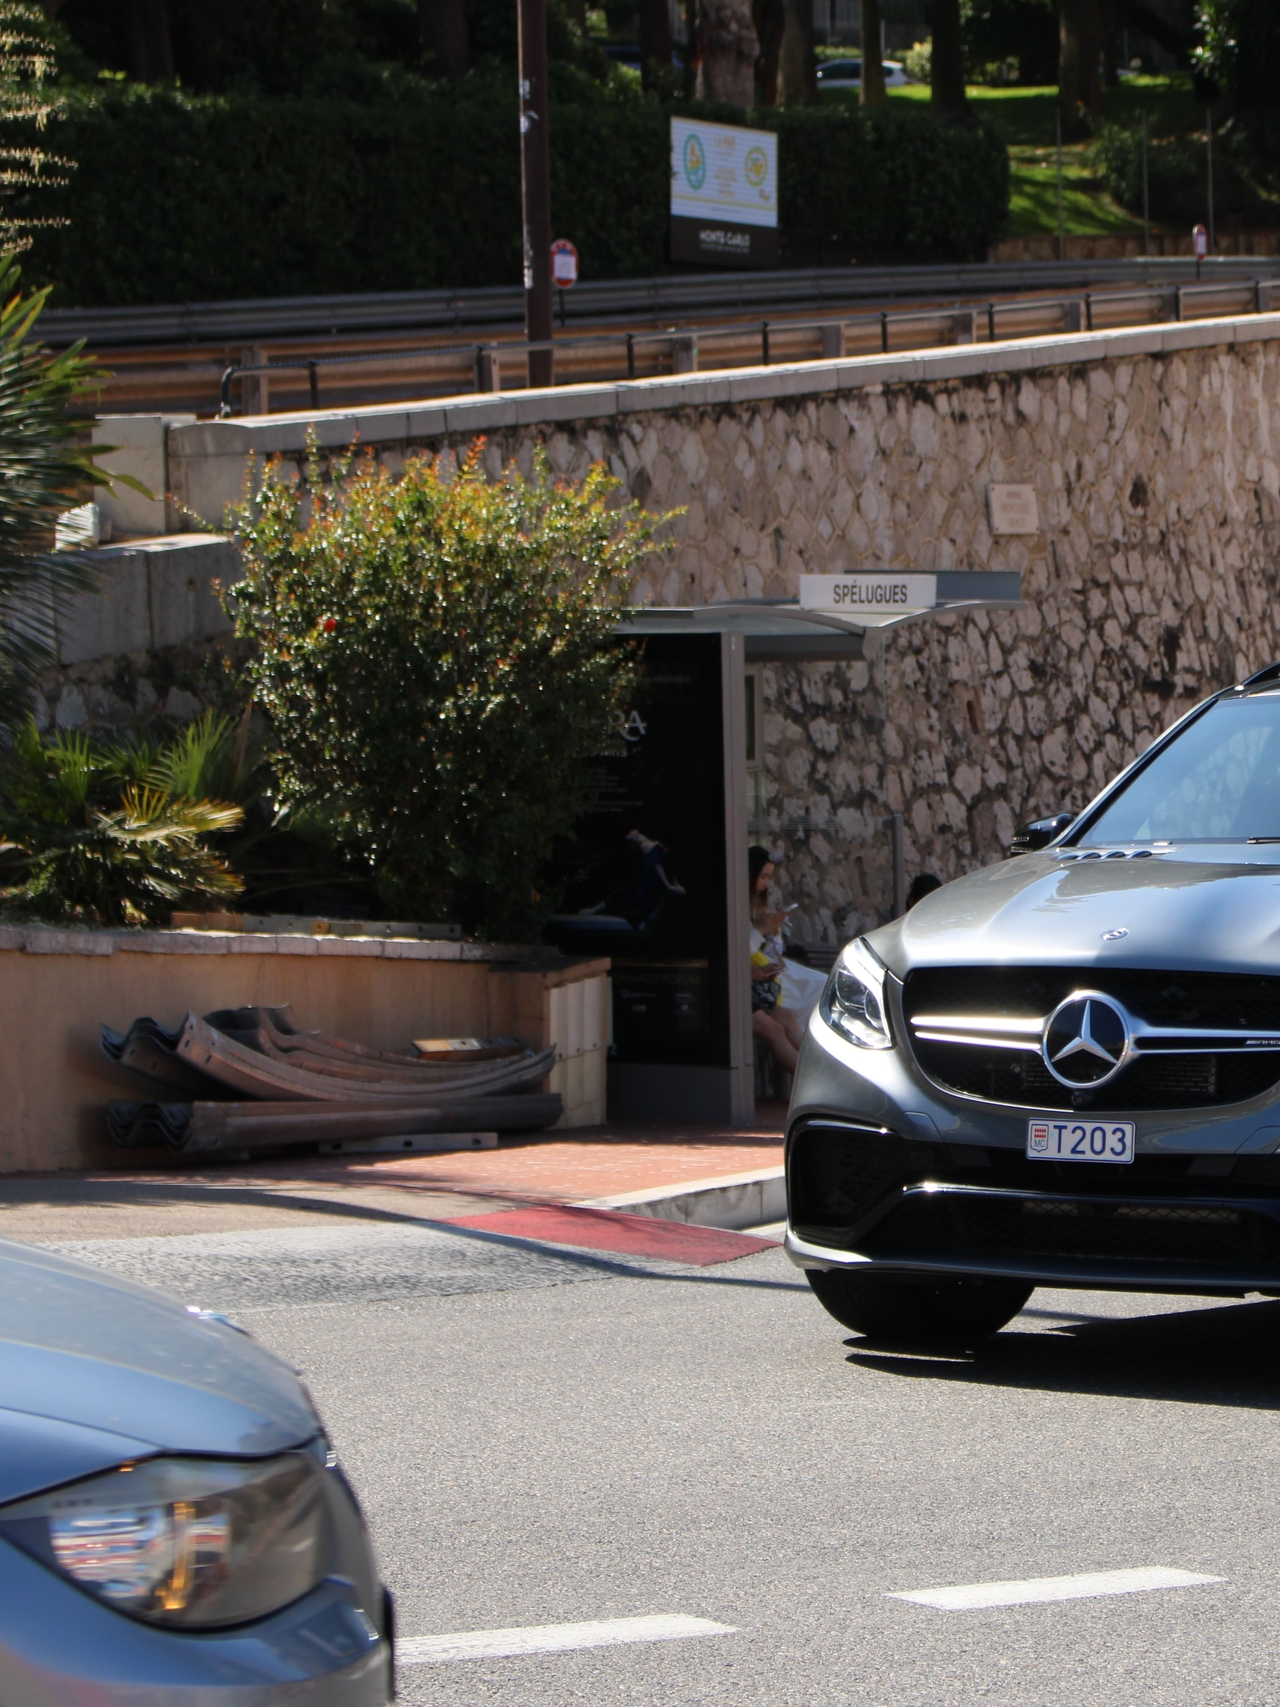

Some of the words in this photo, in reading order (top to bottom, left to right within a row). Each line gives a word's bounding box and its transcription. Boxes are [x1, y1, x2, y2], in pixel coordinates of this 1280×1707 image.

[833, 579, 908, 604] SPÉLUGUES
[1033, 1139, 1046, 1149] MC
[1053, 1124, 1127, 1157] T203
